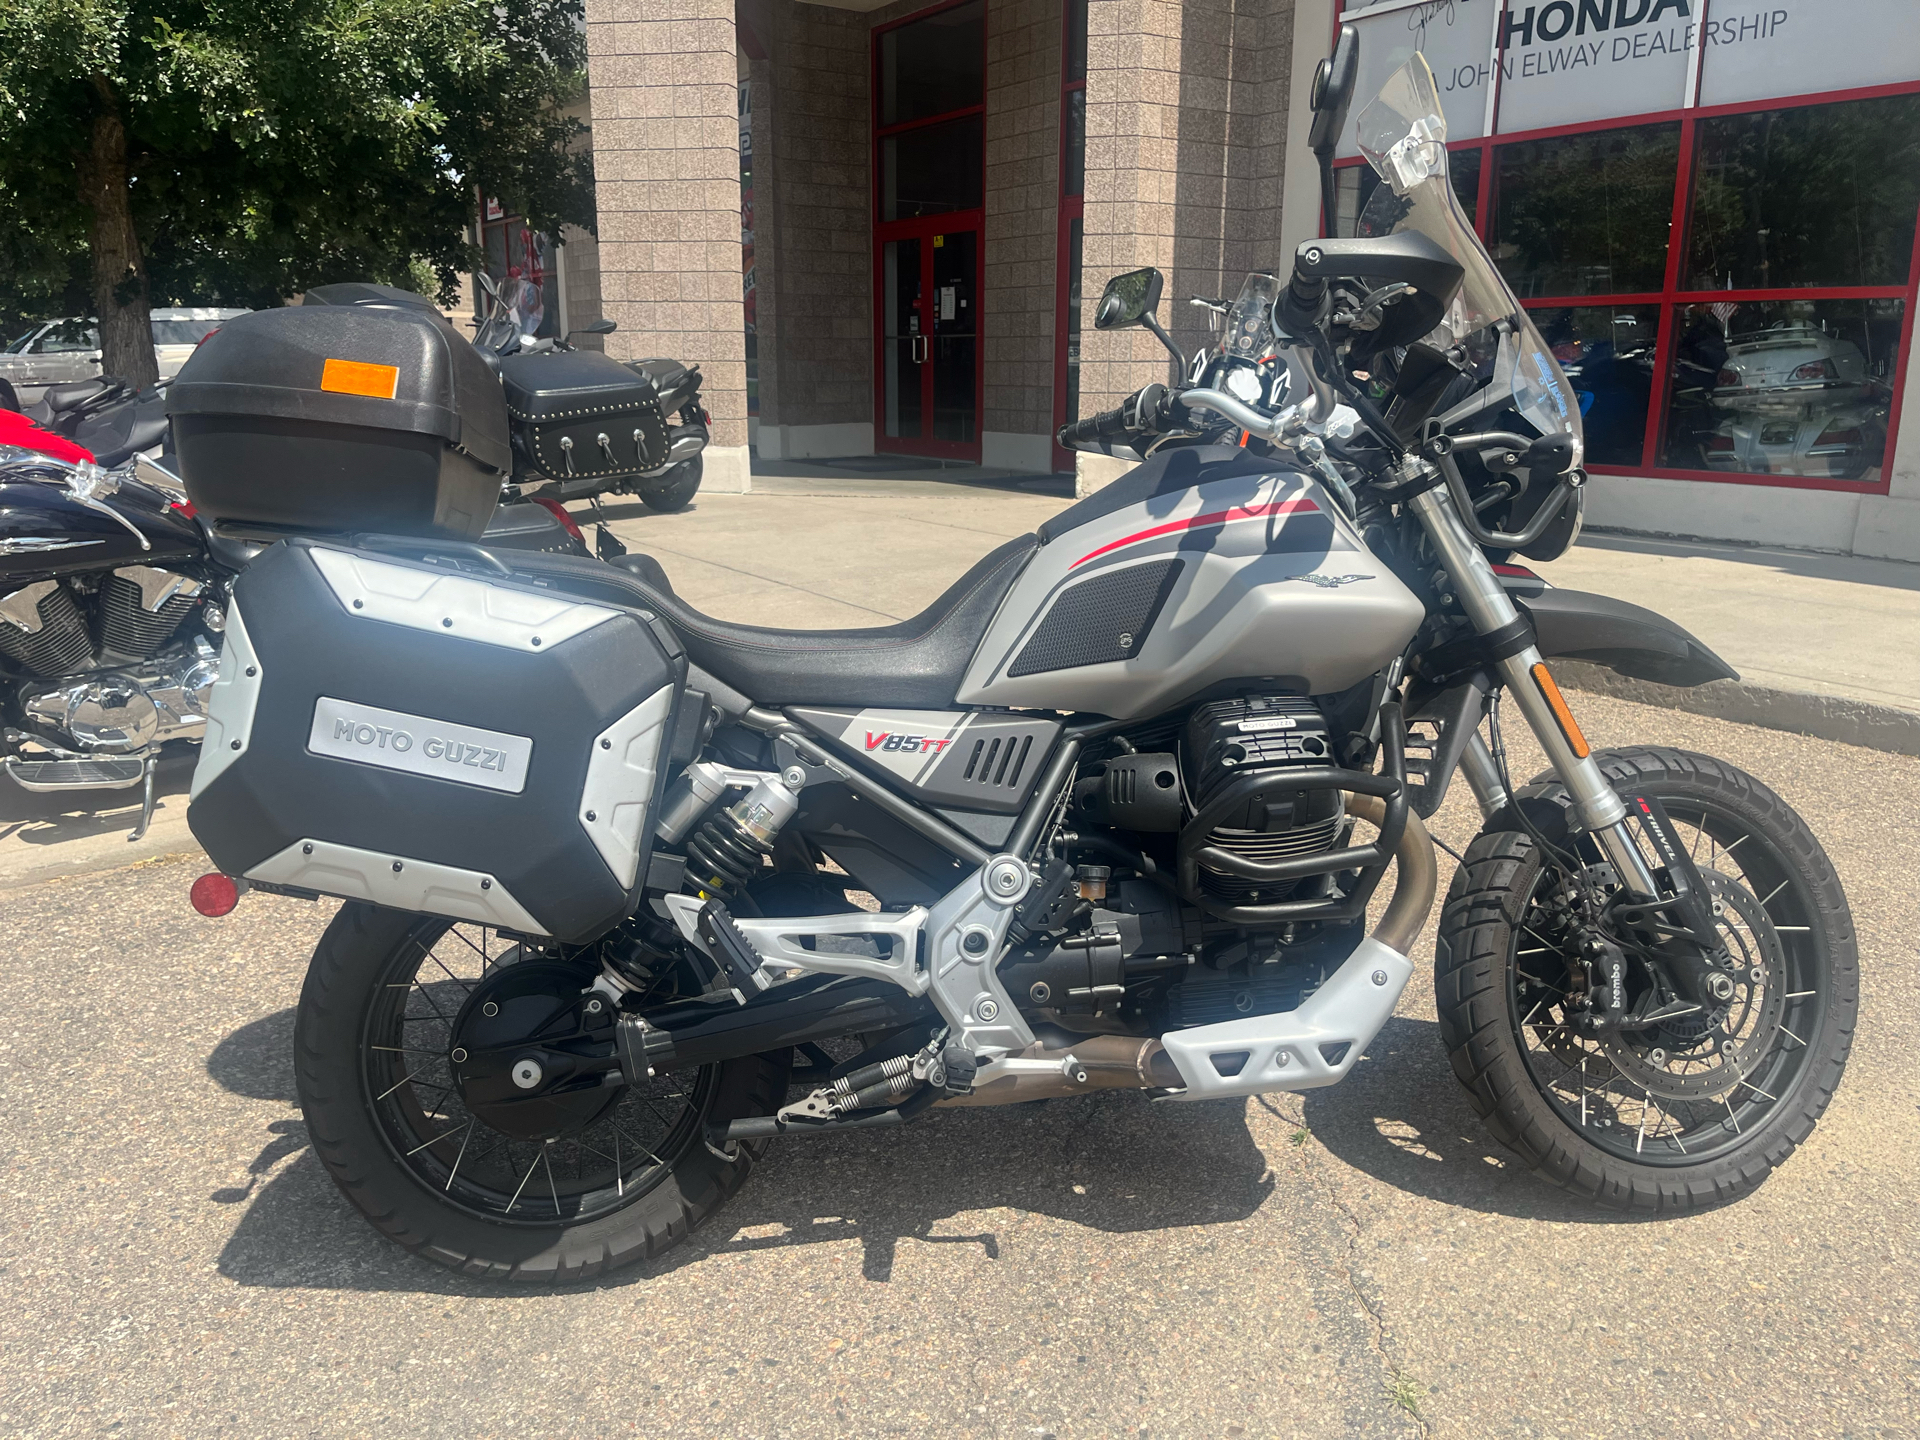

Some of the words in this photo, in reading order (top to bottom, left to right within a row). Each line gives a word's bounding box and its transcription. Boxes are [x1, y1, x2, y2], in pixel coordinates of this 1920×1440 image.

[1495, 0, 1691, 50] HONDA
[1445, 57, 1514, 92] JOHN
[1522, 40, 1605, 78] ELWAY
[1611, 9, 1789, 63] DEALERSHIP
[333, 717, 414, 752] MOTO
[422, 736, 508, 772] GUZZI
[864, 728, 953, 754] V85TT
[1646, 812, 1676, 861] TRAVEL
[1610, 963, 1621, 1008] brembo
